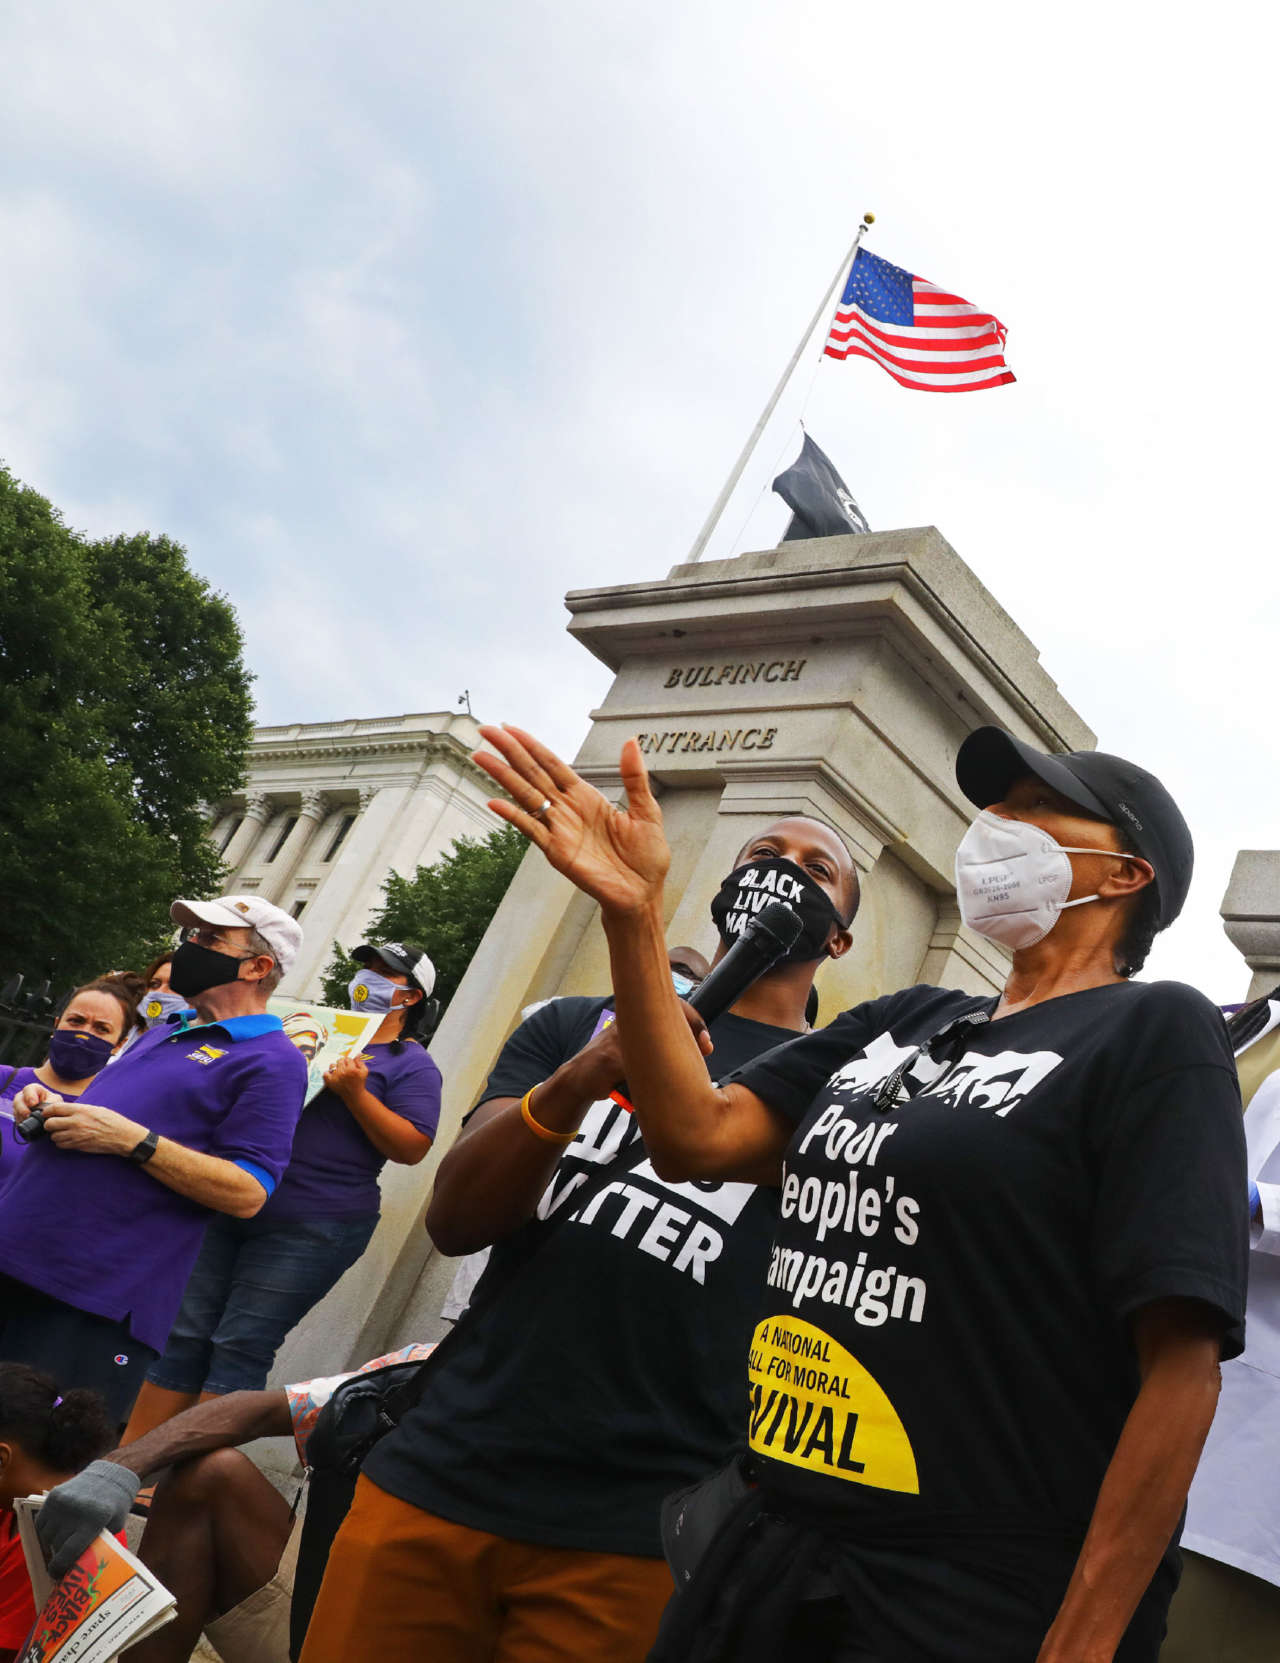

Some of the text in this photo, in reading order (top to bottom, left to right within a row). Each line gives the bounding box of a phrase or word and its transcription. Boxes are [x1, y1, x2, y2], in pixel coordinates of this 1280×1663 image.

[663, 658, 808, 689] BULFINCH
[637, 727, 778, 754] ENTRANCE
[738, 868, 806, 904] BLACK
[797, 1103, 900, 1167] Poor
[780, 1160, 921, 1247] eople's
[766, 1240, 928, 1328] ampaign
[759, 1323, 832, 1363] A NATIONAL
[767, 1355, 793, 1383] FOR
[793, 1365, 851, 1400] MORAL
